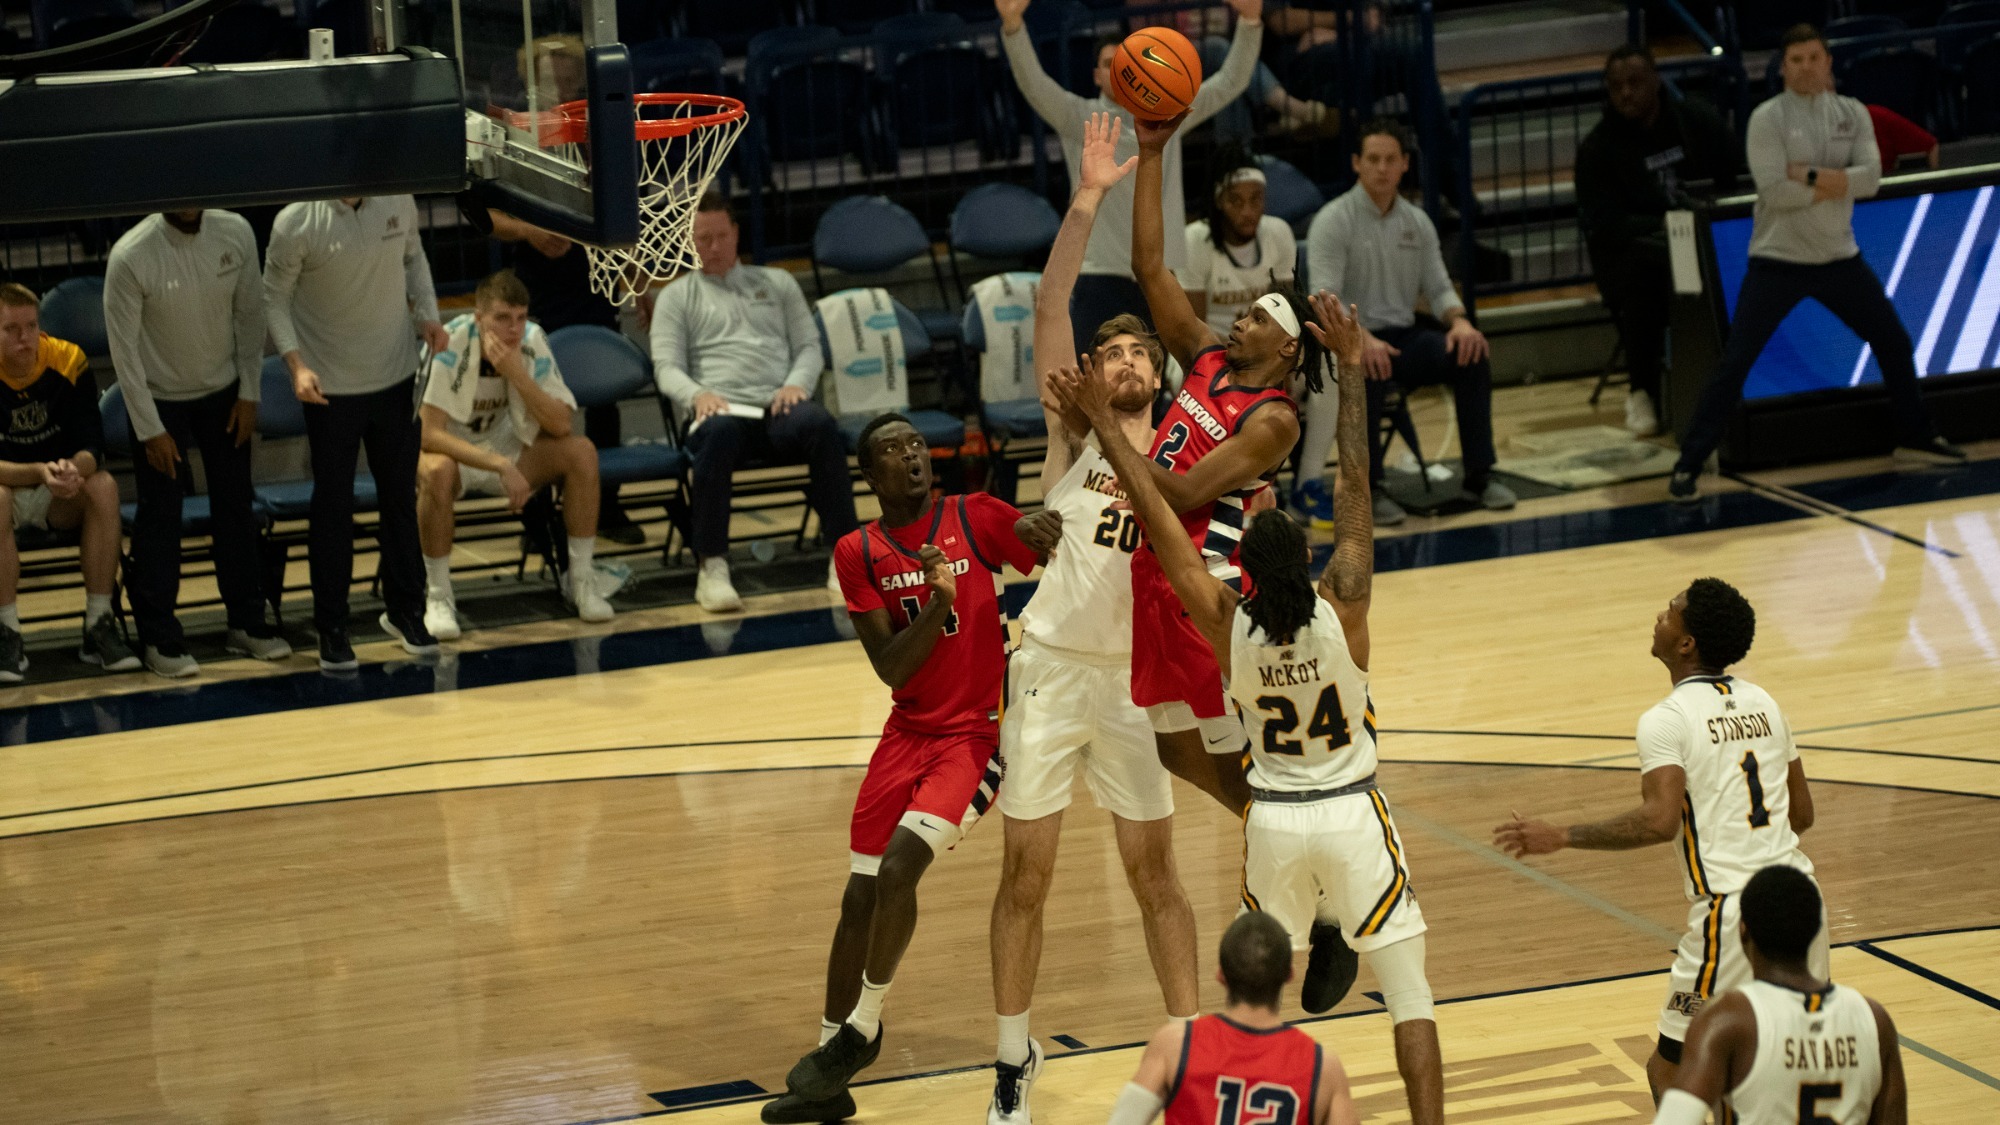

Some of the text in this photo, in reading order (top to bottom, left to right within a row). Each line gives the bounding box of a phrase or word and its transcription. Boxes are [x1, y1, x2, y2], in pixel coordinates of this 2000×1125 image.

[1121, 65, 1161, 106] ELITE
[1177, 389, 1228, 441] SAMFORD
[1153, 421, 1189, 471] 2
[1094, 506, 1141, 554] 20
[881, 558, 970, 591] SAMRD
[1254, 681, 1352, 756] 24
[1707, 712, 1772, 744] STINSON
[1739, 749, 1771, 830] 1
[1785, 1035, 1858, 1070] SAVAGE
[1215, 1074, 1300, 1125] 12
[1796, 1081, 1843, 1125] 5
